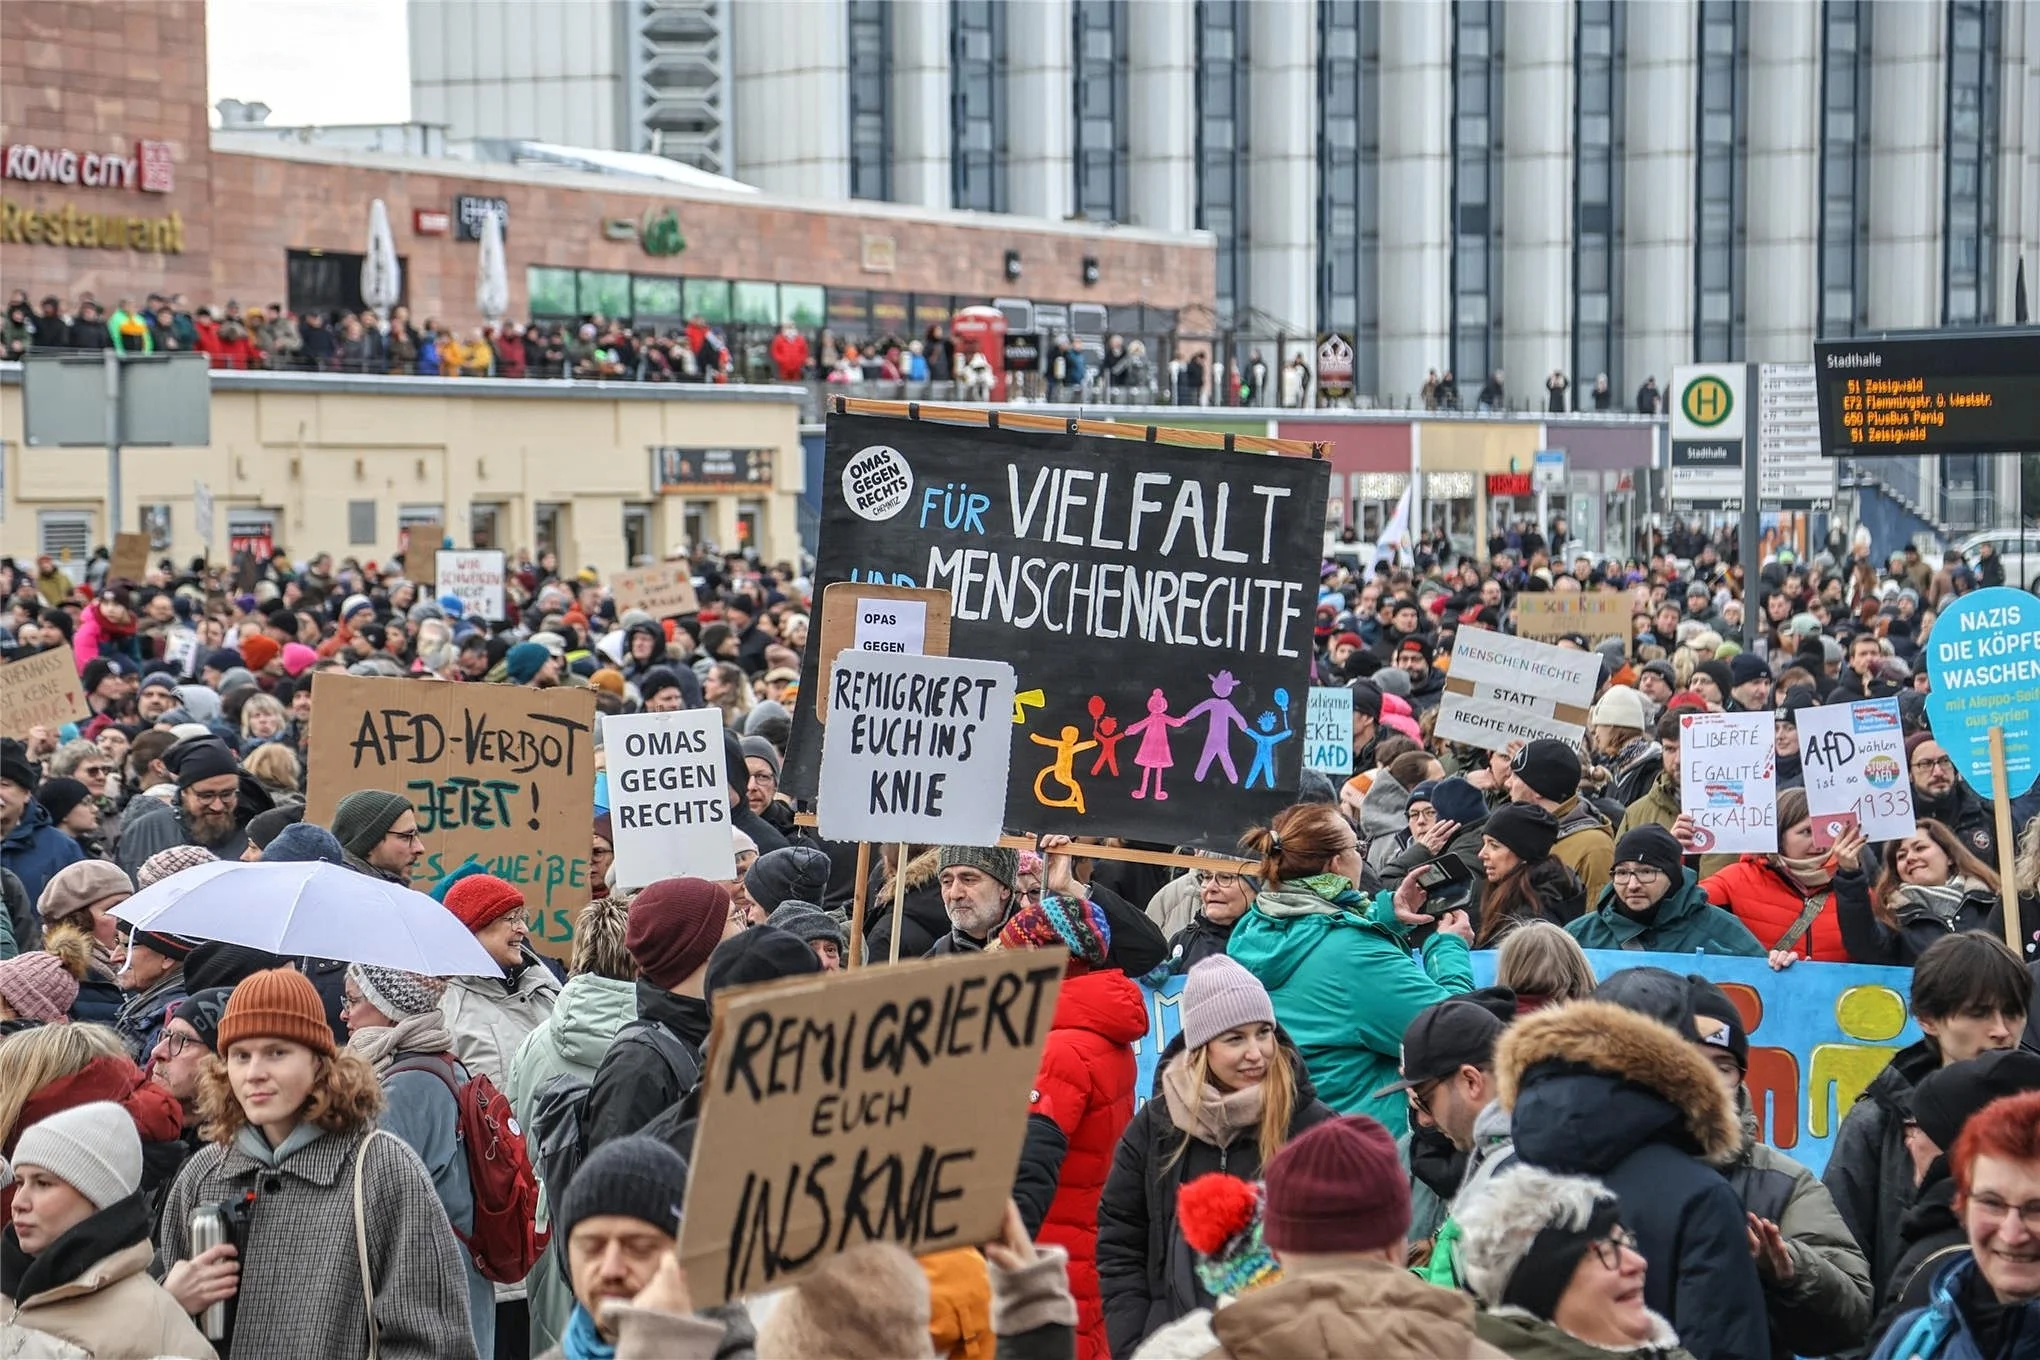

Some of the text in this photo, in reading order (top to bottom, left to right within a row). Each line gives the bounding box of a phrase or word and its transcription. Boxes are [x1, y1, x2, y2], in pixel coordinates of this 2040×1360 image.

[5, 144, 78, 184] KONG
[81, 151, 137, 188] CITY
[0, 203, 185, 253] Restaurant
[1826, 352, 1882, 369] Stadthalle
[1865, 377, 1924, 396] Zeisigwald
[1913, 409, 1945, 427] Penig
[1868, 426, 1927, 444] Zeisigwald
[850, 450, 890, 479] OMAS
[1687, 447, 1727, 459] Stadthalle
[853, 463, 900, 494] GEGEN
[856, 476, 907, 510] RECHTS
[920, 463, 1292, 565] FÜR VIELFALT
[925, 546, 1303, 659] MENSCHENRECHTE
[864, 613, 897, 625] OPAS
[1960, 606, 2021, 632] NAZIS
[863, 641, 905, 653] GEGEN
[1939, 631, 2040, 662] DIE KÖPFE
[1531, 663, 1581, 684] RECHTE
[1943, 659, 2040, 690] WASCHEN
[834, 668, 997, 722] REMIGRIERT
[1493, 688, 1537, 707] STATT
[1945, 698, 1966, 711] mit
[1454, 709, 1504, 733] RECHTE
[1965, 714, 1987, 728] aus
[350, 707, 589, 776] AFD-VERBOT
[625, 730, 707, 757] OMAS
[851, 713, 976, 761] EUCH INS
[1692, 724, 1760, 749] LIBERTÉ
[1804, 730, 1897, 773] AfD wählen
[620, 764, 717, 793] GEGEN
[1691, 761, 1762, 783] EGALITÉ
[1816, 775, 1836, 789] ist
[407, 775, 520, 834] JETZT
[869, 769, 946, 817] KNIE
[1850, 789, 1911, 820] 1933
[619, 799, 724, 829] RECHTS
[723, 965, 1061, 1103] REMIGRIERT
[810, 1086, 911, 1137] EUCH
